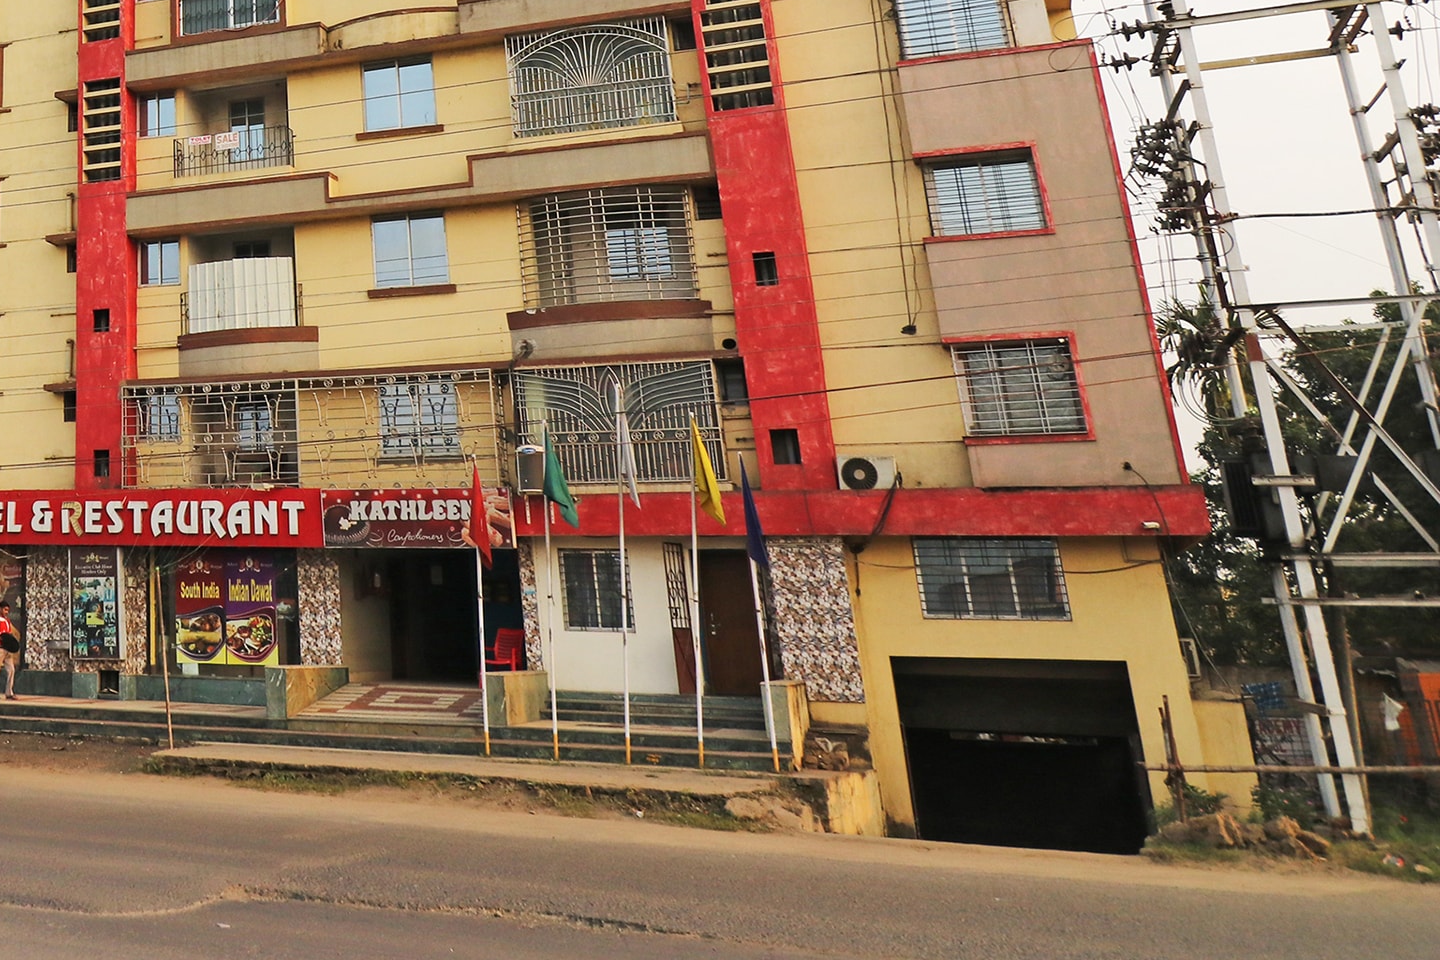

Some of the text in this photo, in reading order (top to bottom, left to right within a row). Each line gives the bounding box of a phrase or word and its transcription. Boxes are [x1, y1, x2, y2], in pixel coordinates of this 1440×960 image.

[216, 133, 238, 144] SALE
[31, 501, 54, 533] &
[61, 500, 304, 538] RESTAURANT
[180, 581, 220, 599] South India
[228, 578, 273, 602] Indian Dawat
